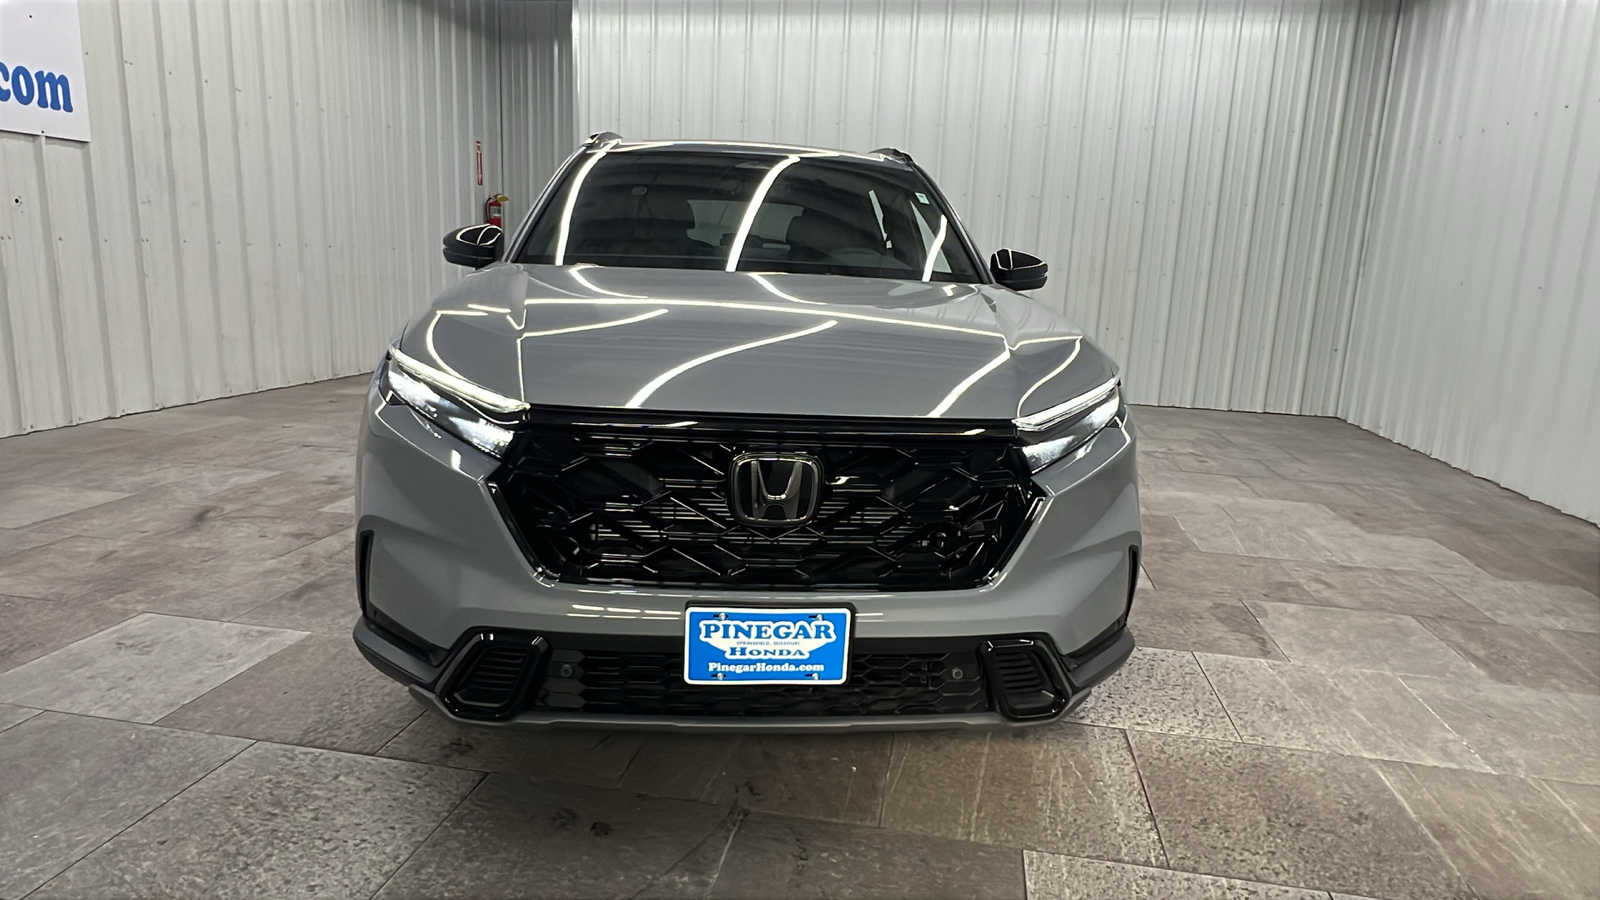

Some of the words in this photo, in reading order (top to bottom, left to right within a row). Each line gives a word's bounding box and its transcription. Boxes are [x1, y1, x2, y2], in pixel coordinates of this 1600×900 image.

[703, 623, 833, 640] PINEGAR
[729, 647, 806, 656] HONDA
[708, 662, 825, 673] PinegarHonda.com
